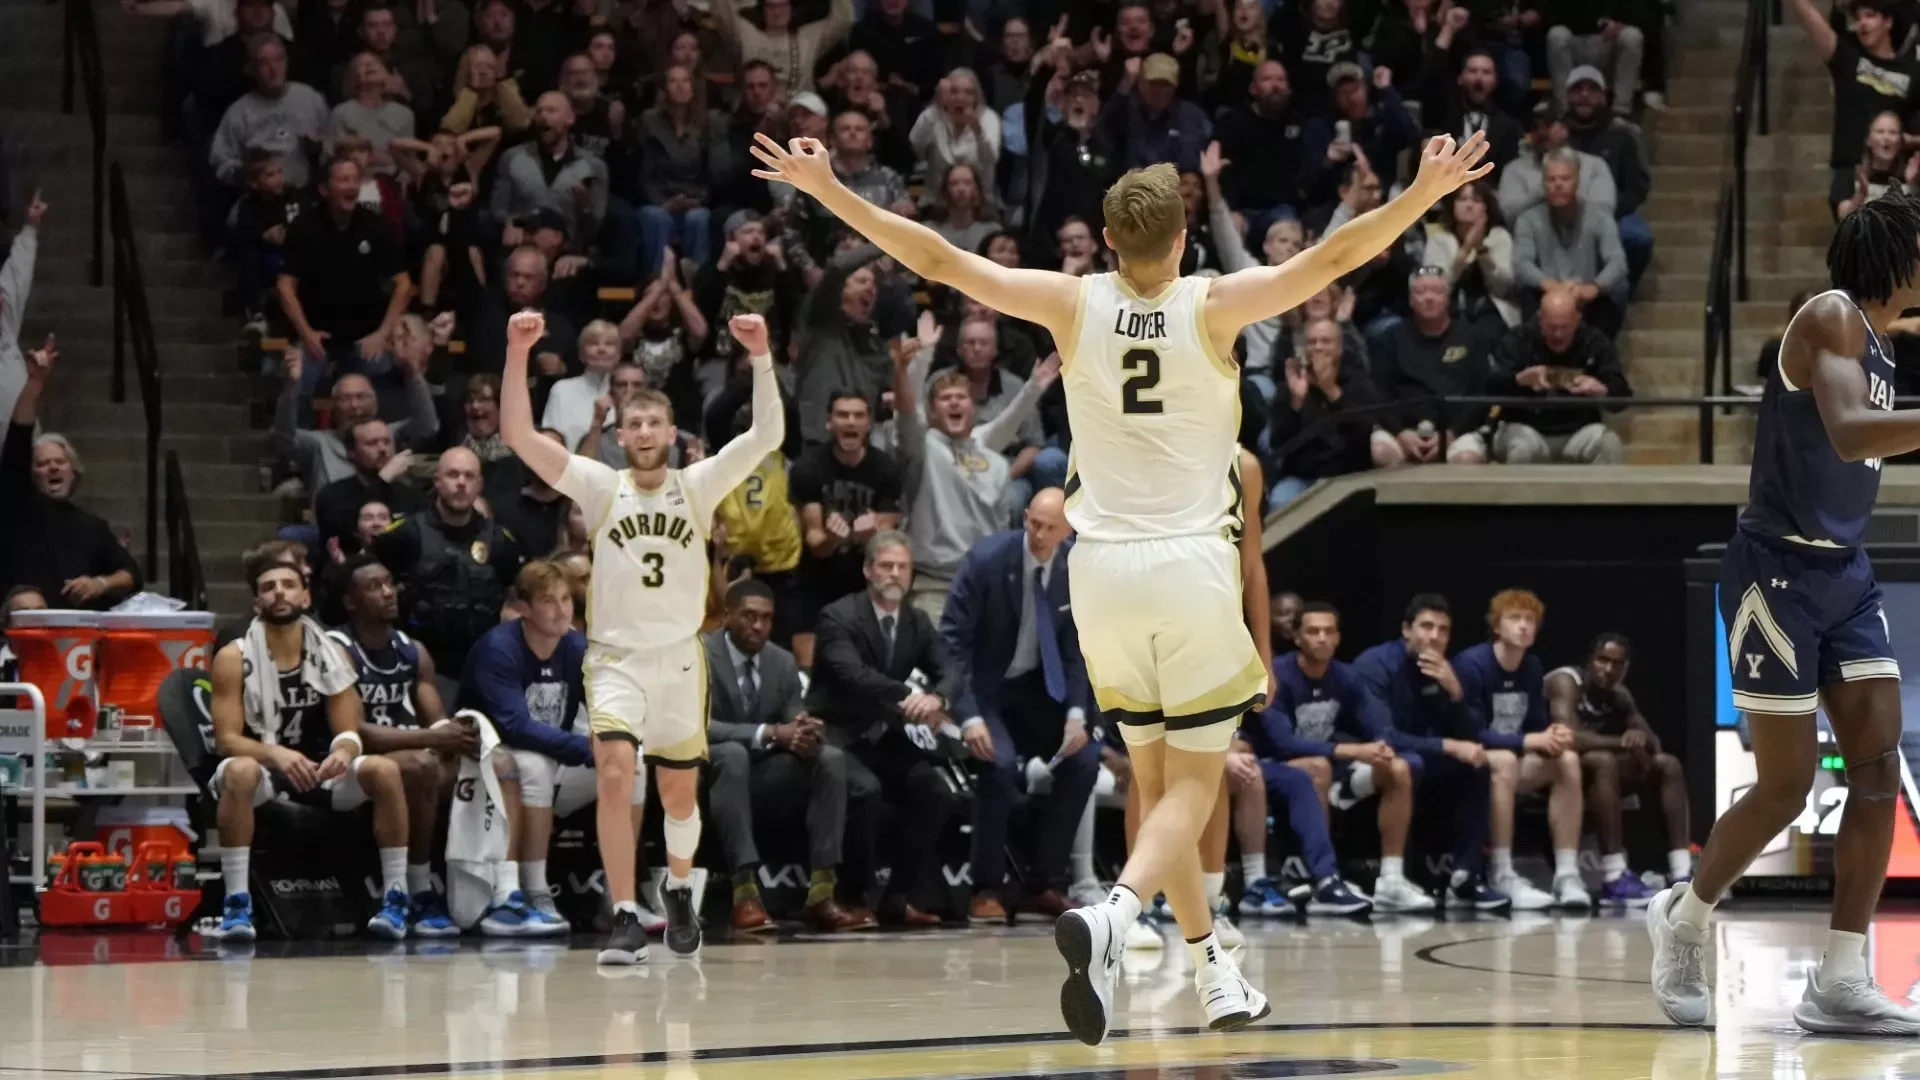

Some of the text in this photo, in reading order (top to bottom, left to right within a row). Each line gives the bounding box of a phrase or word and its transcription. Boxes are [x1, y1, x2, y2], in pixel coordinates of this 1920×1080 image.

[1115, 308, 1167, 340] LOYER
[1122, 349, 1163, 414] 2
[745, 475, 764, 506] 2
[608, 512, 694, 549] PURDUE
[642, 552, 664, 588] 3
[66, 644, 92, 681] G
[1745, 653, 1764, 679] Y
[93, 898, 110, 921] G
[164, 896, 181, 918] G
